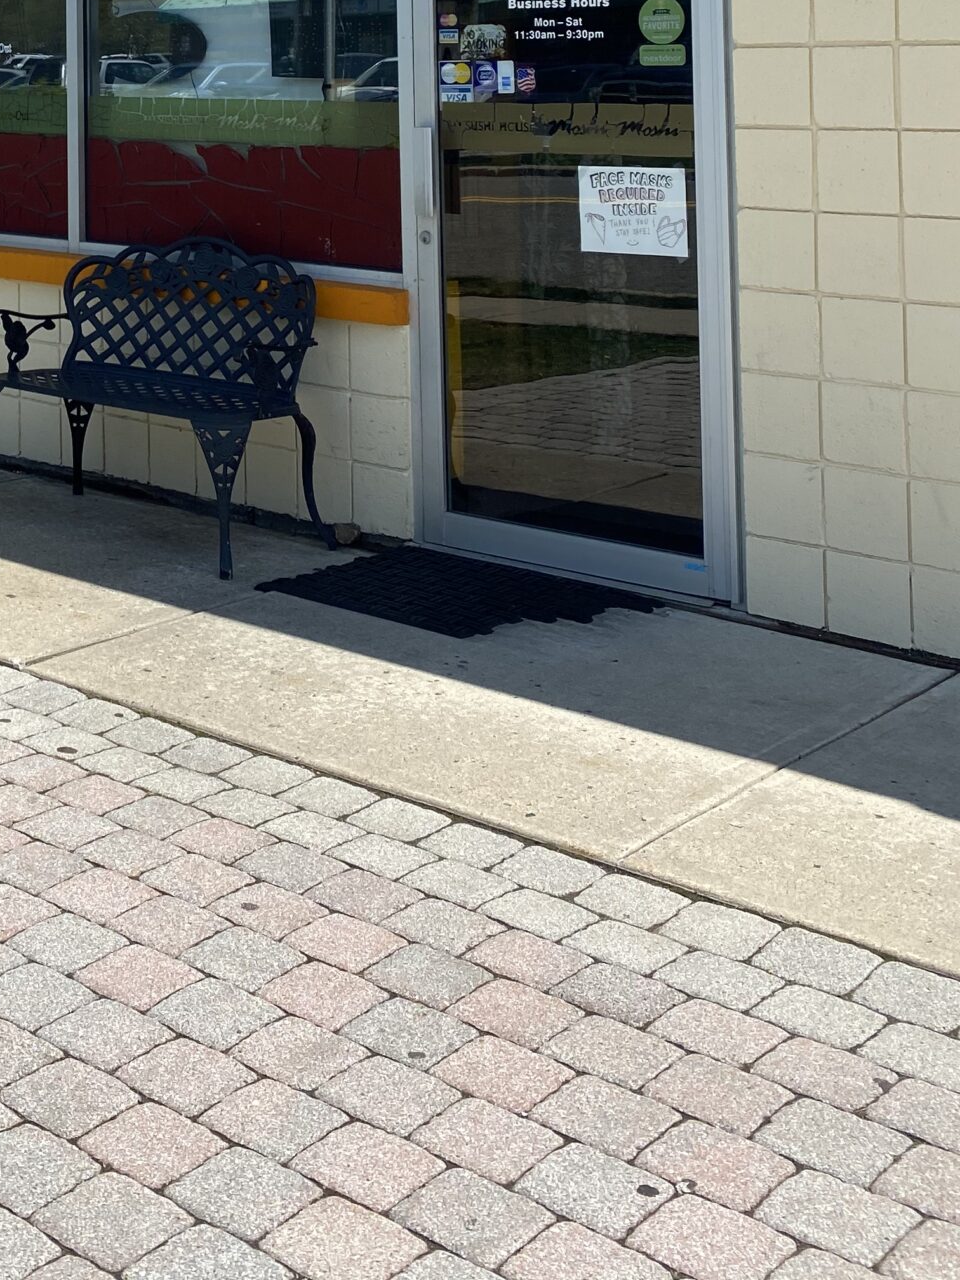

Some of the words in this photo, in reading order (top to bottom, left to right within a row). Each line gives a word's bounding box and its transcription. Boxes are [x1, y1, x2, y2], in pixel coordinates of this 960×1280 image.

[534, 17, 556, 27] Mon
[566, 17, 583, 27] Sat
[514, 30, 556, 40] 11:30am
[565, 30, 604, 41] 9:30pm
[462, 38, 506, 50] SMOKING
[445, 93, 468, 102] VISA
[589, 170, 625, 188] FACE
[630, 171, 673, 189] MASKS
[598, 186, 666, 204] REQUIRED
[612, 203, 657, 216] INSIDE
